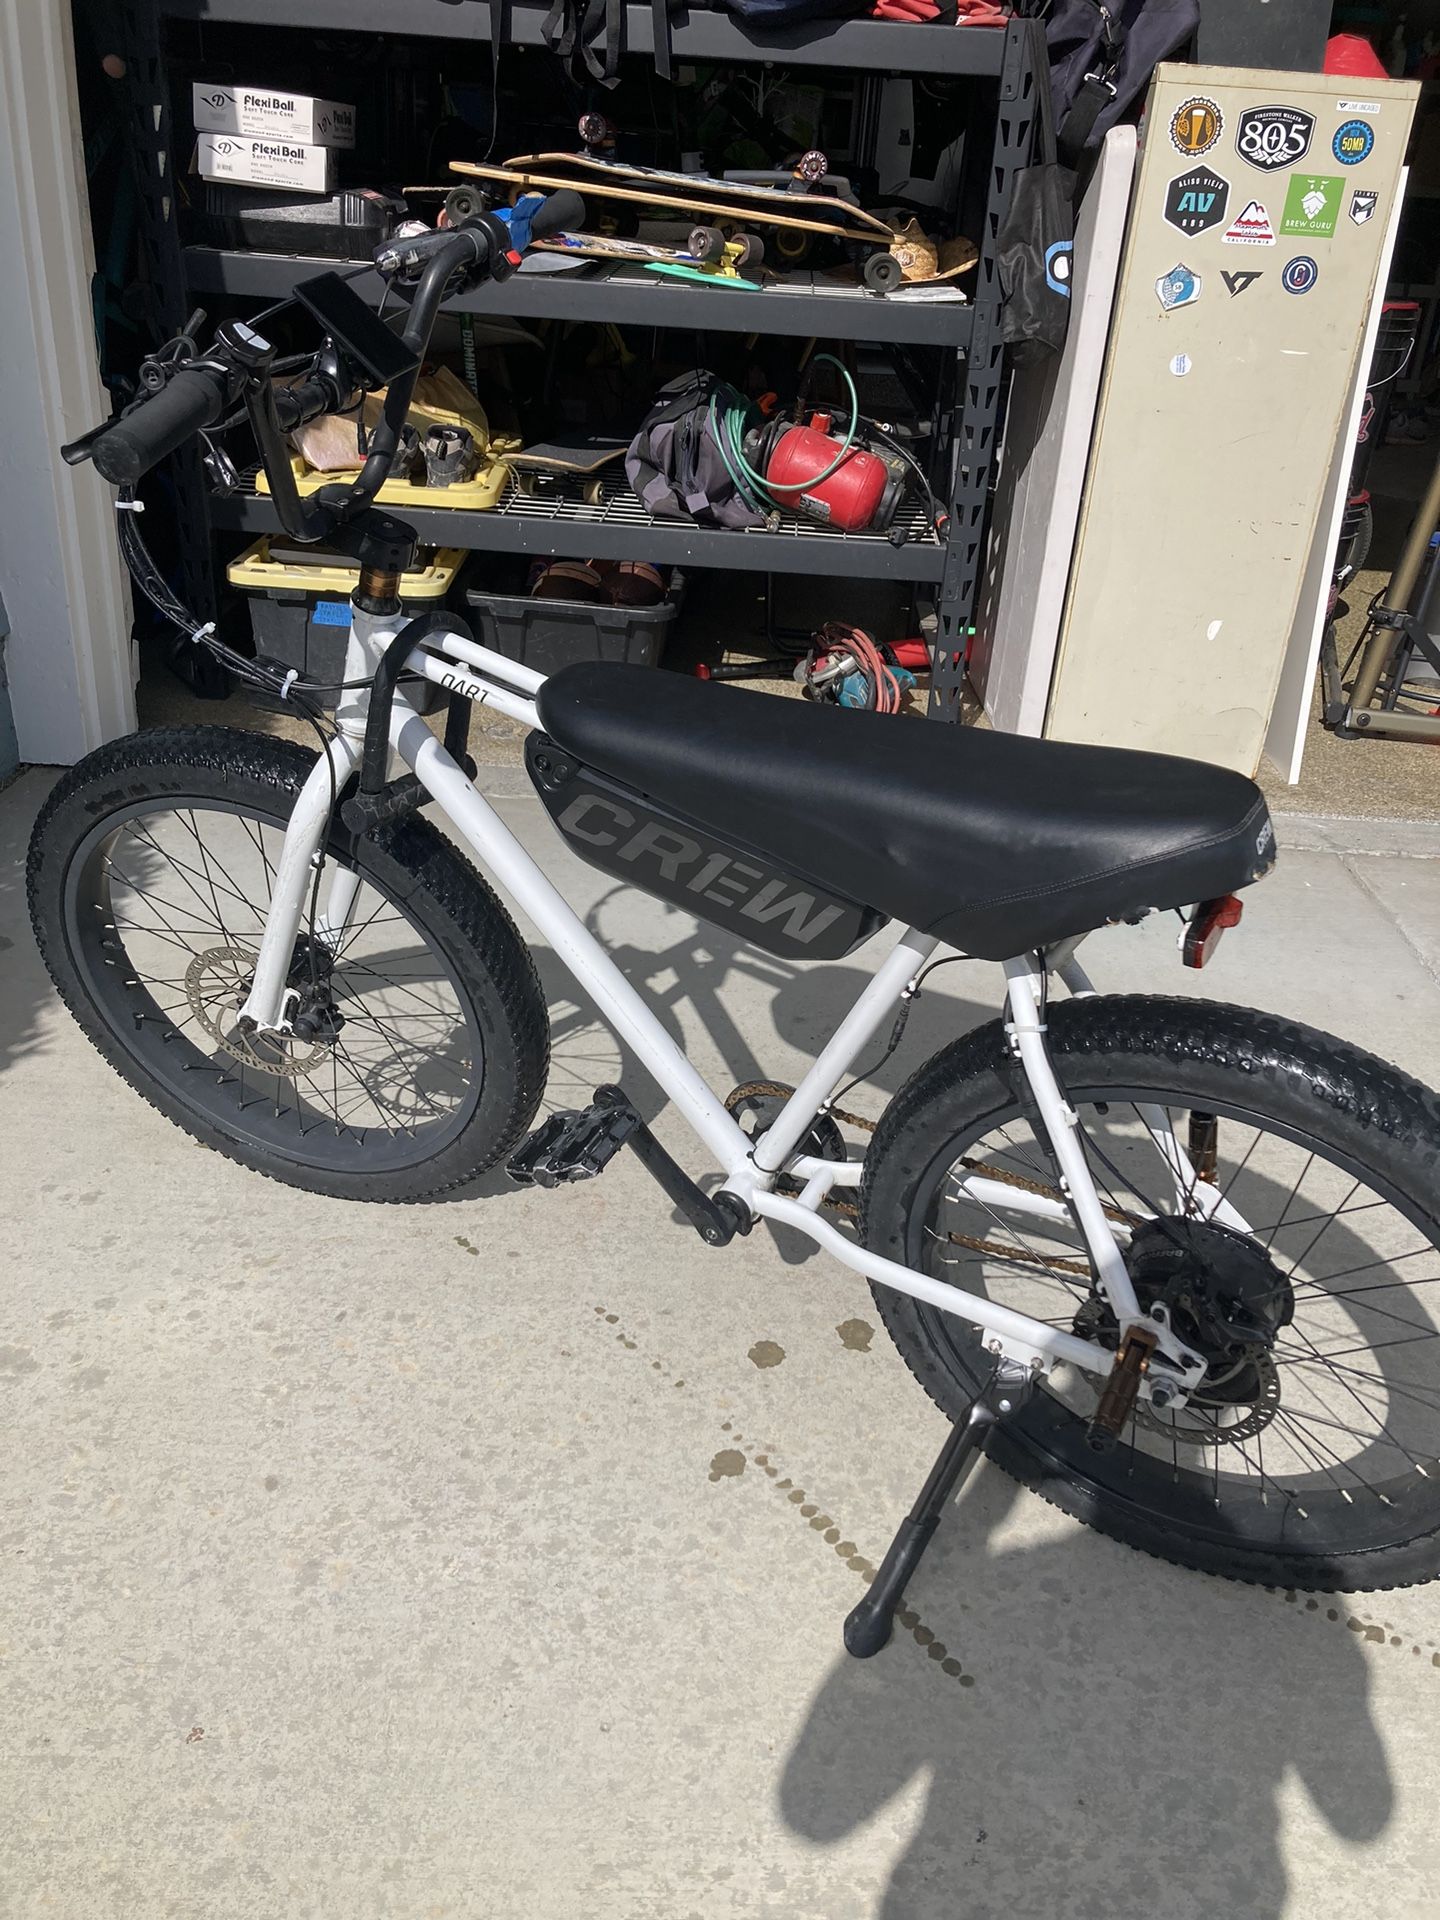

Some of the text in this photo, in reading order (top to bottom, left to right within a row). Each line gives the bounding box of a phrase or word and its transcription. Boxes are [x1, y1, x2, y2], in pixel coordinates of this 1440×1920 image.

[243, 94, 294, 112] Flexi Ball
[1283, 112, 1302, 122] WALKER
[1240, 121, 1308, 155] 805
[252, 142, 305, 160] Flexi Ball
[1178, 177, 1224, 190] ALISO VIEJO
[1176, 192, 1216, 213] AV
[1285, 219, 1332, 230] BREW GURU
[1227, 237, 1269, 245] CALIFORNIA
[1219, 270, 1265, 299] YT
[440, 672, 489, 703] DART
[557, 794, 846, 945] CREW
